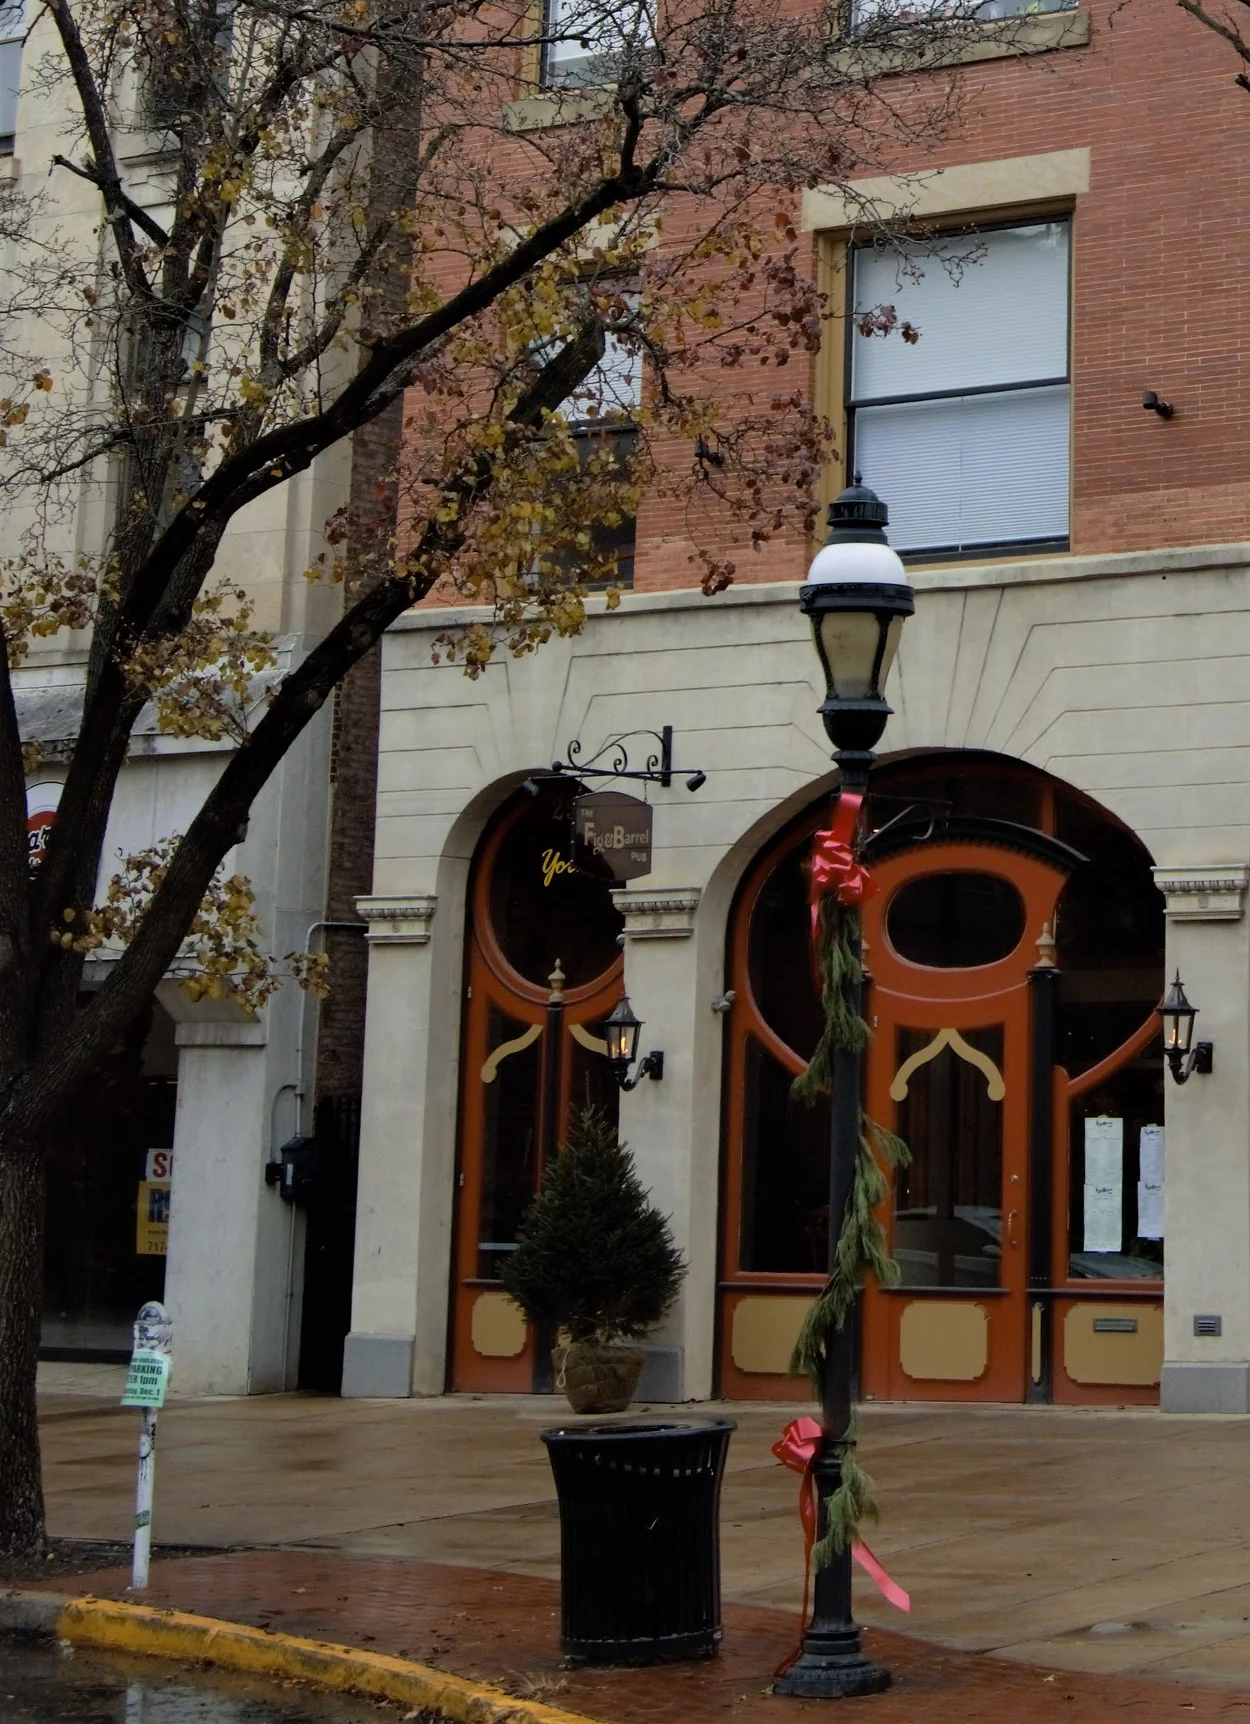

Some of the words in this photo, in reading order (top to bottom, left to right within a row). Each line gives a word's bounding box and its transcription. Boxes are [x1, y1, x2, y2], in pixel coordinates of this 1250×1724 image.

[581, 809, 594, 818] THE
[631, 851, 648, 862] PUB
[139, 1376, 158, 1385] 1pm
